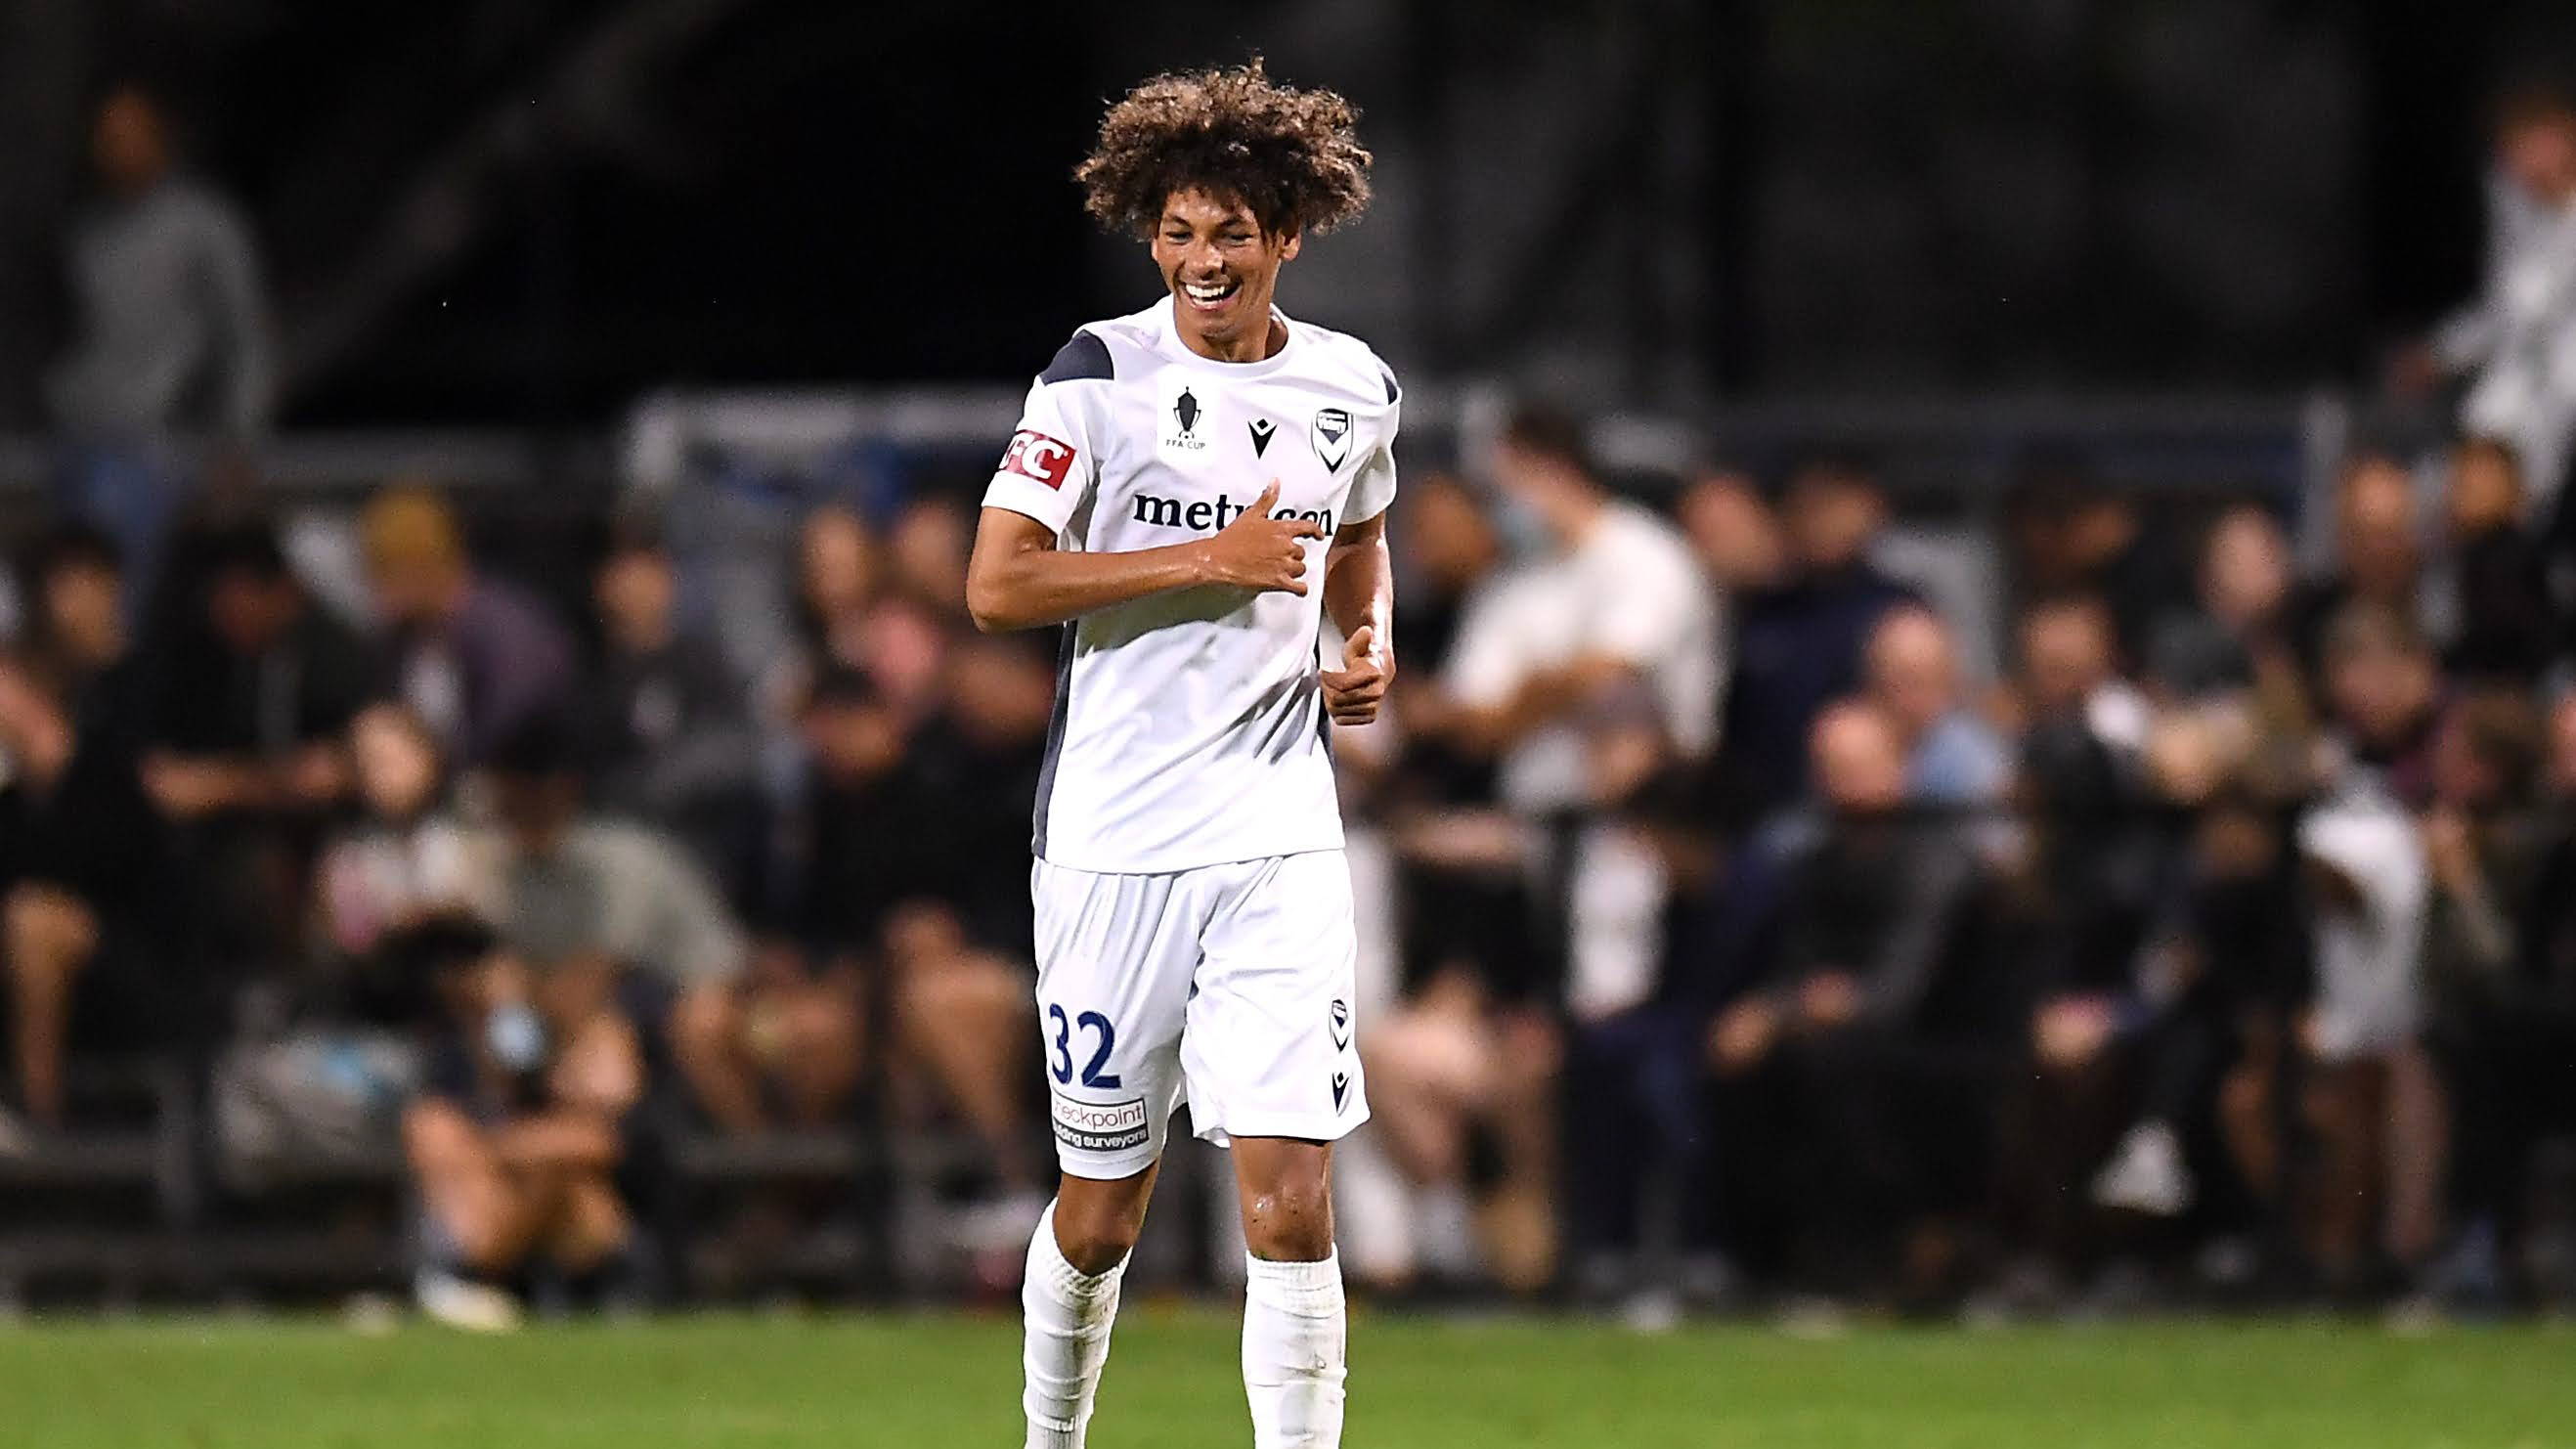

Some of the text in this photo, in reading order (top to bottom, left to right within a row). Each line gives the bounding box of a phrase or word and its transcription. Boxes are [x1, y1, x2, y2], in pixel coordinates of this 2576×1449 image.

[999, 432, 1065, 479] FC
[1188, 441, 1205, 450] CUP
[1049, 1003, 1122, 1089] 32
[1083, 1127, 1147, 1149] surveyors
